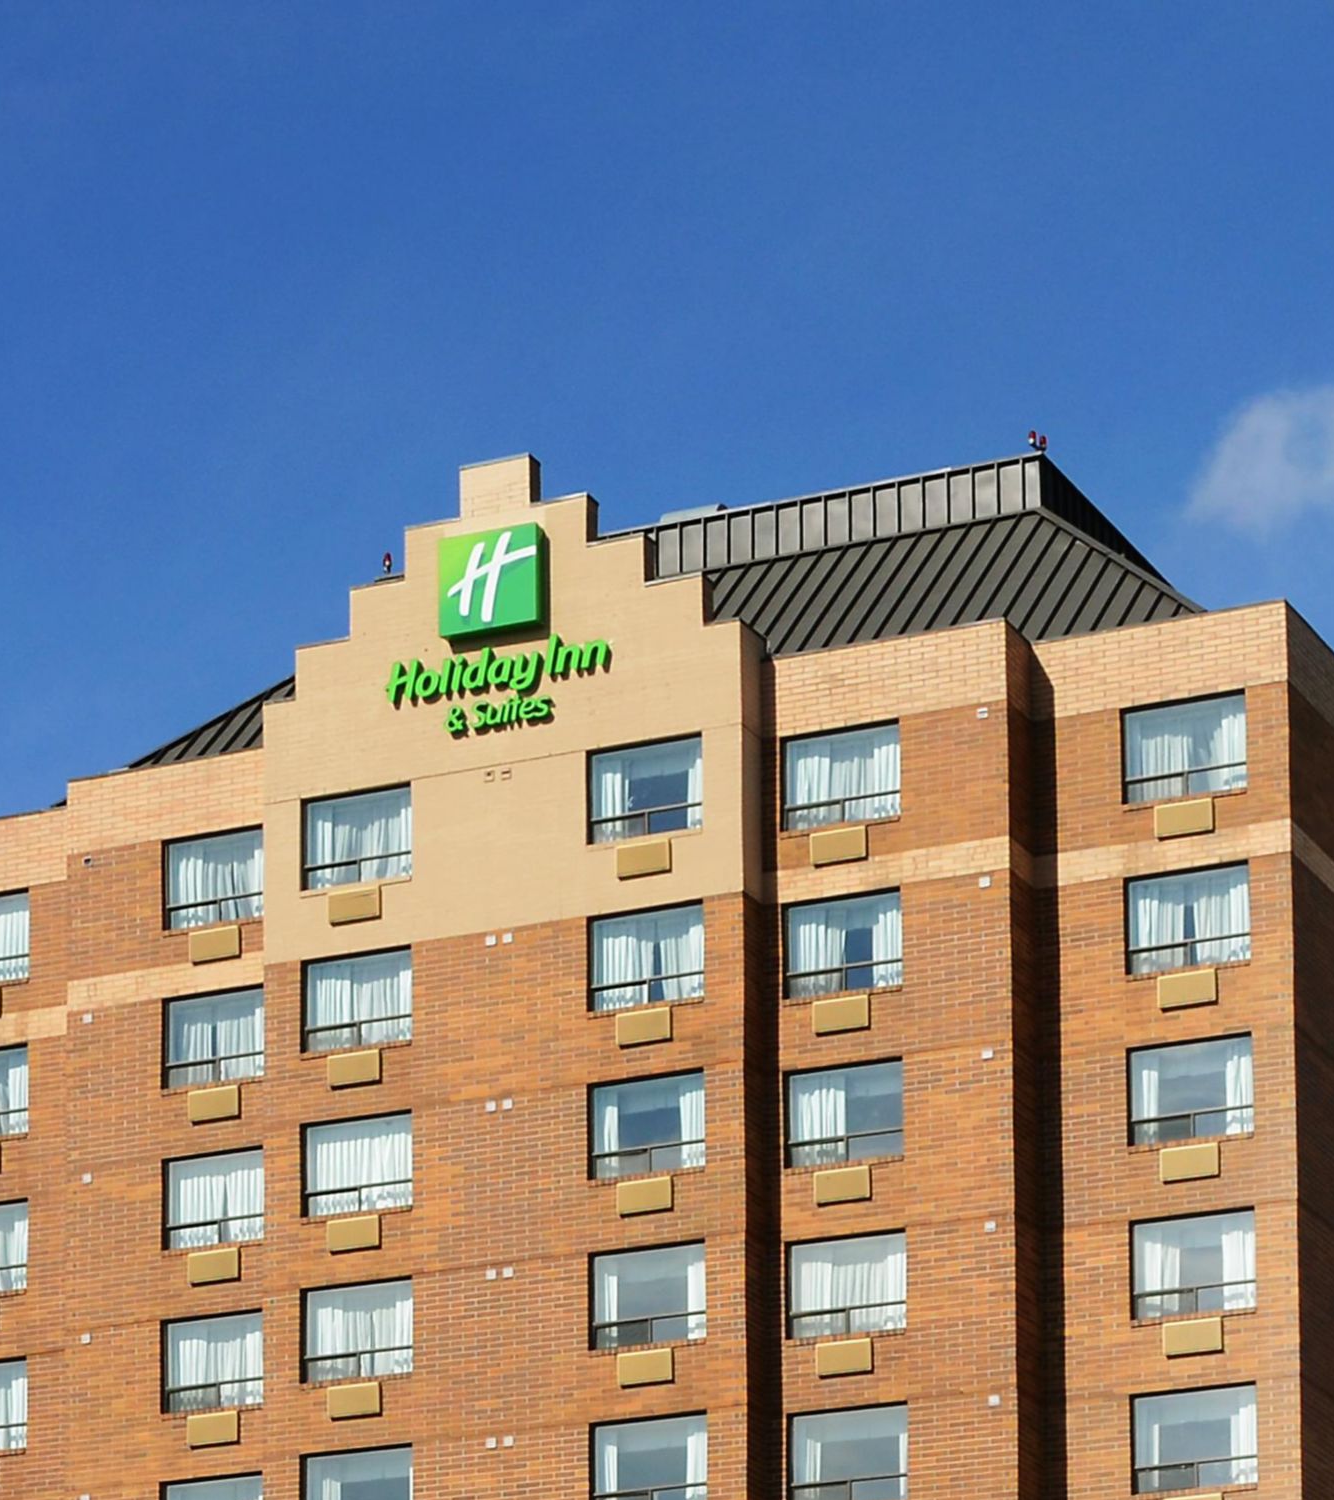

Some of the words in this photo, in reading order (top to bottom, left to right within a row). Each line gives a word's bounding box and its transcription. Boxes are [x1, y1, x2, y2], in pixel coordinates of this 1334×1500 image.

[386, 646, 540, 702] Holiday
[544, 633, 611, 676] Inn
[444, 704, 464, 733] &
[471, 694, 552, 731] Suites
